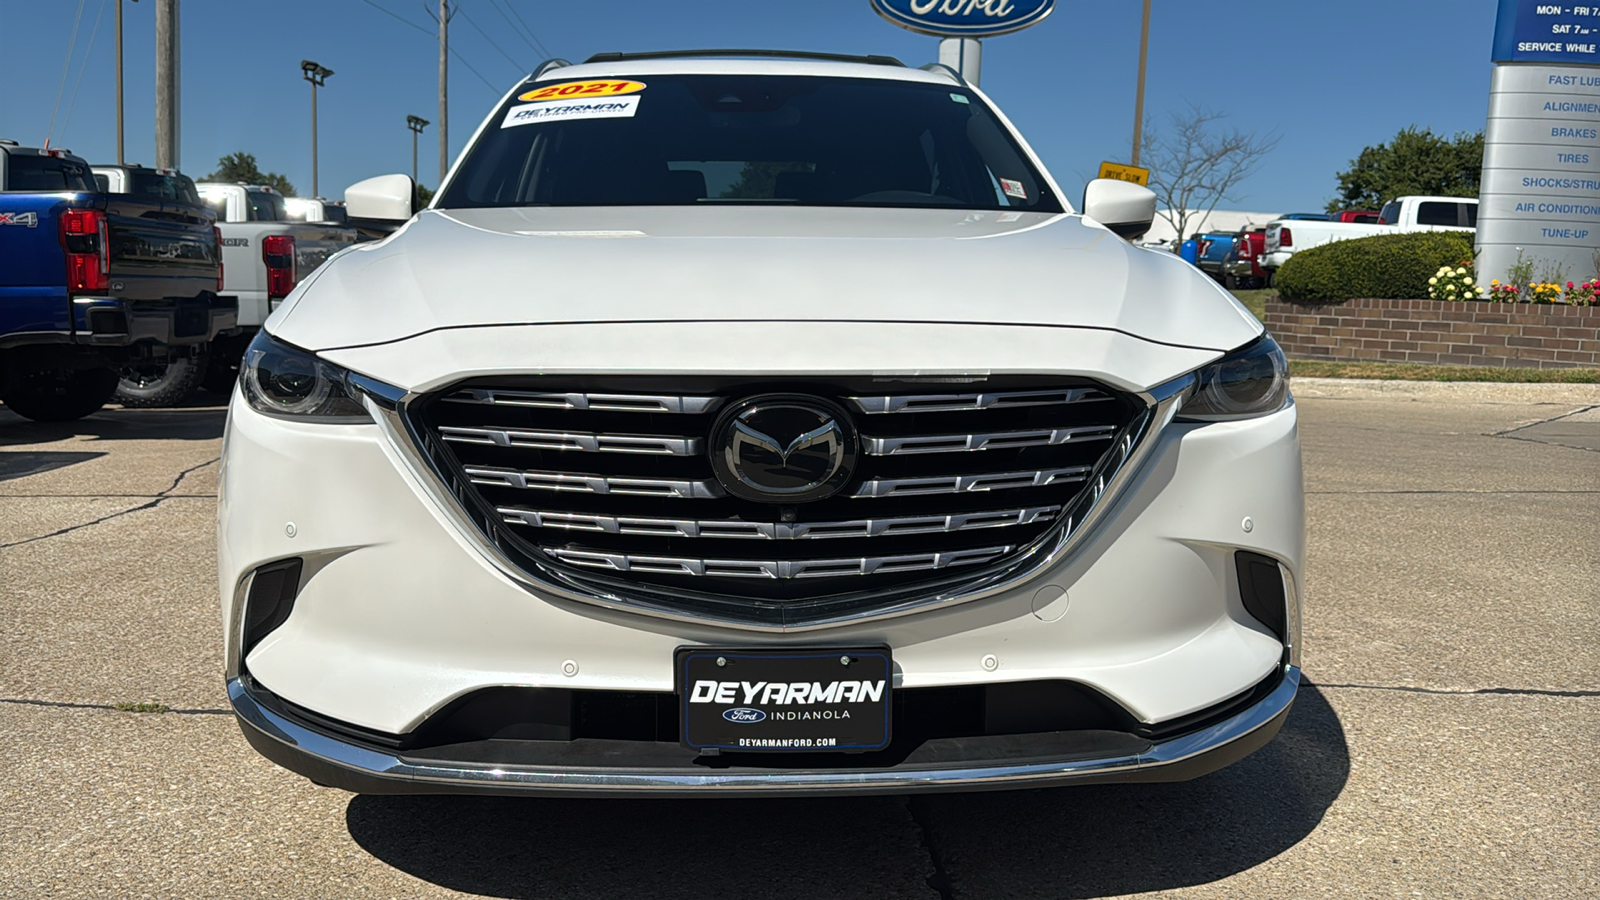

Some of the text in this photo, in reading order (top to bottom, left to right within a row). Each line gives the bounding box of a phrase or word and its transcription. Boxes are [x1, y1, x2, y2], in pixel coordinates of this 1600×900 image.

[1536, 5, 1562, 15] MON
[1573, 6, 1590, 16] FRI
[1552, 24, 1572, 34] SAT
[1517, 42, 1596, 53] SERVICE WHILE
[1548, 75, 1578, 85] FAST
[530, 82, 630, 100] 2021
[513, 102, 630, 119] DEYARMAN
[1551, 127, 1597, 139] BRAKES
[1557, 153, 1589, 164] TIRES
[1515, 203, 1536, 213] AIR
[1541, 228, 1589, 239] TUNE-UP
[689, 680, 886, 705] DEYARMAN
[730, 709, 851, 721] Ford INDIANOLA
[739, 738, 837, 748] DEYARMANFORD.COM
